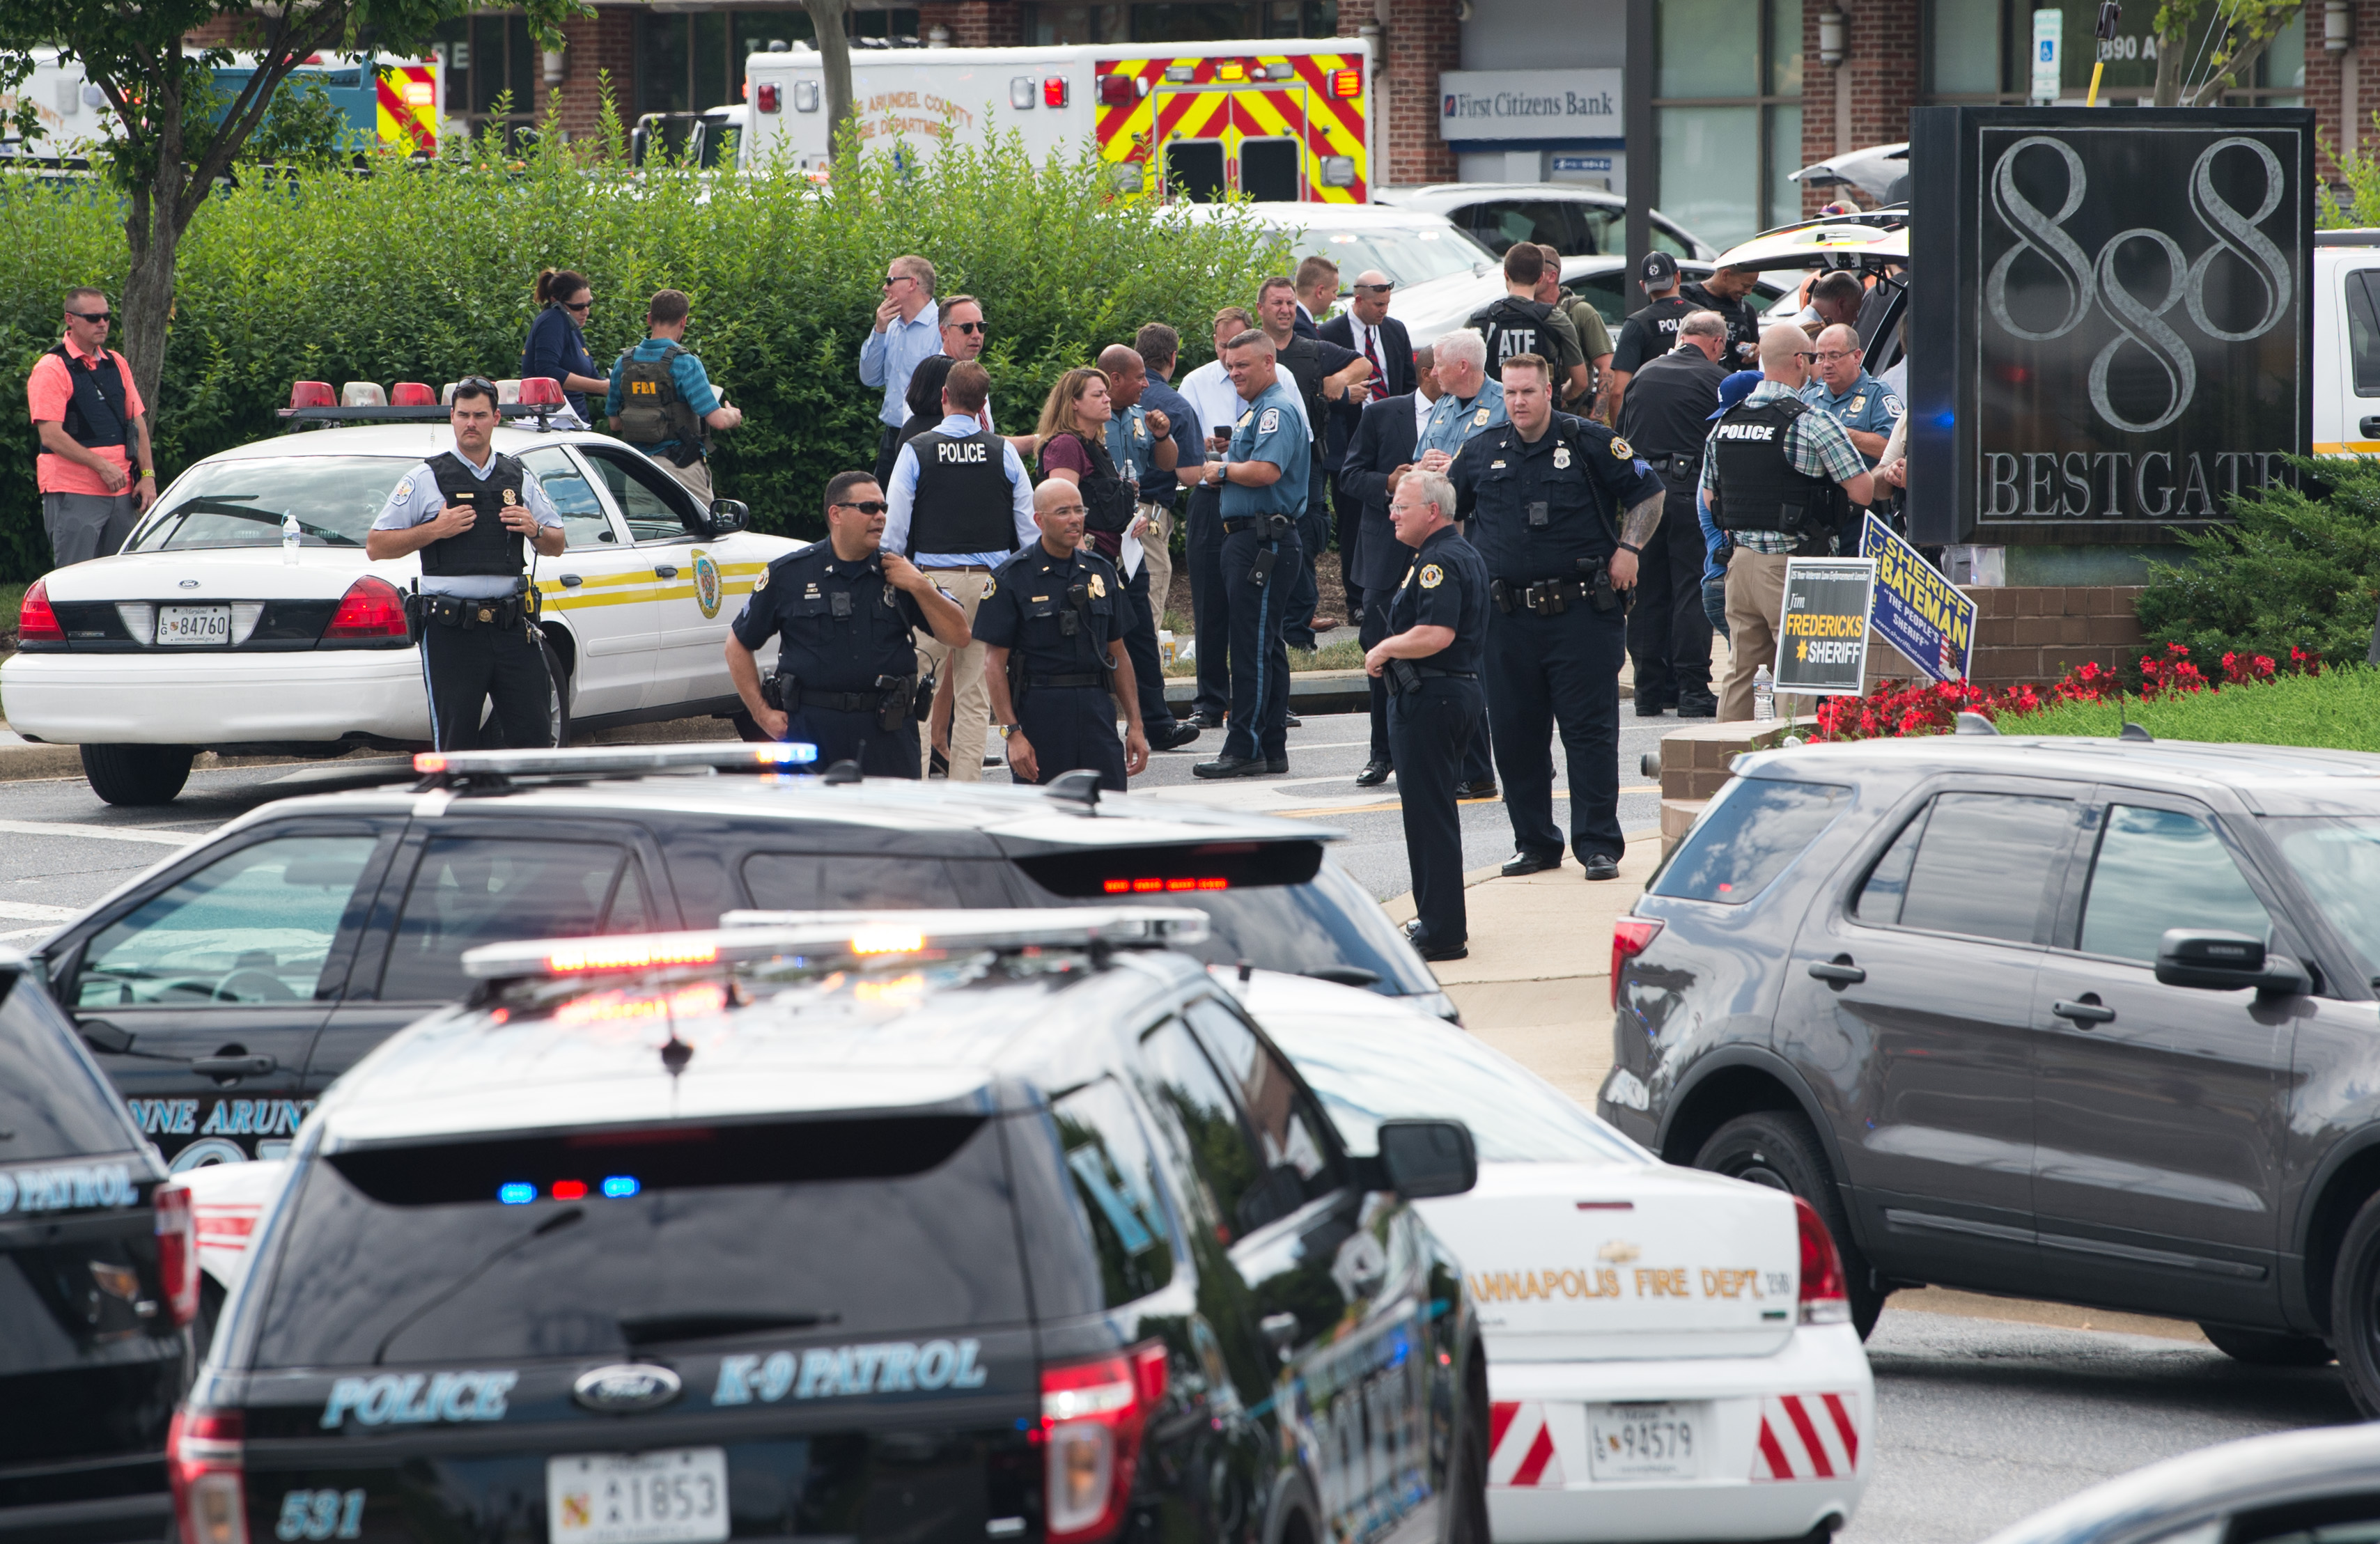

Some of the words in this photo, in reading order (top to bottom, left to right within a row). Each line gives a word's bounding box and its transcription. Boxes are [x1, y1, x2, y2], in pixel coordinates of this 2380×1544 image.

[1459, 93, 1492, 117] First
[1495, 91, 1562, 116] Citizens
[1565, 91, 1613, 115] Bank
[1658, 318, 1682, 332] POLI
[1499, 329, 1535, 356] ATF
[632, 381, 656, 394] FBI
[1717, 424, 1775, 440] POLICE
[938, 443, 987, 462] POLICE
[1984, 451, 2292, 516] BESTGATE
[1885, 536, 1970, 616] SHERIFF
[1787, 593, 1805, 611] Jim
[1881, 552, 1968, 651] BATEMAN
[180, 617, 225, 634] 84760
[1785, 614, 1863, 637] FREDERICKS
[1807, 641, 1861, 664] SHERIFF
[1875, 618, 1945, 680] www.sheriffbateman.com
[127, 1099, 199, 1134] NNE
[200, 1099, 320, 1134] ARUN
[17, 1164, 139, 1212] PATROL
[1634, 1268, 1691, 1298] FIRE
[1702, 1268, 1764, 1299] DEPT.
[319, 1370, 519, 1429] POLICE
[712, 1350, 798, 1406] K-9
[797, 1338, 988, 1398] PATROL
[631, 1472, 717, 1522] 1853
[277, 1488, 366, 1541] 531
